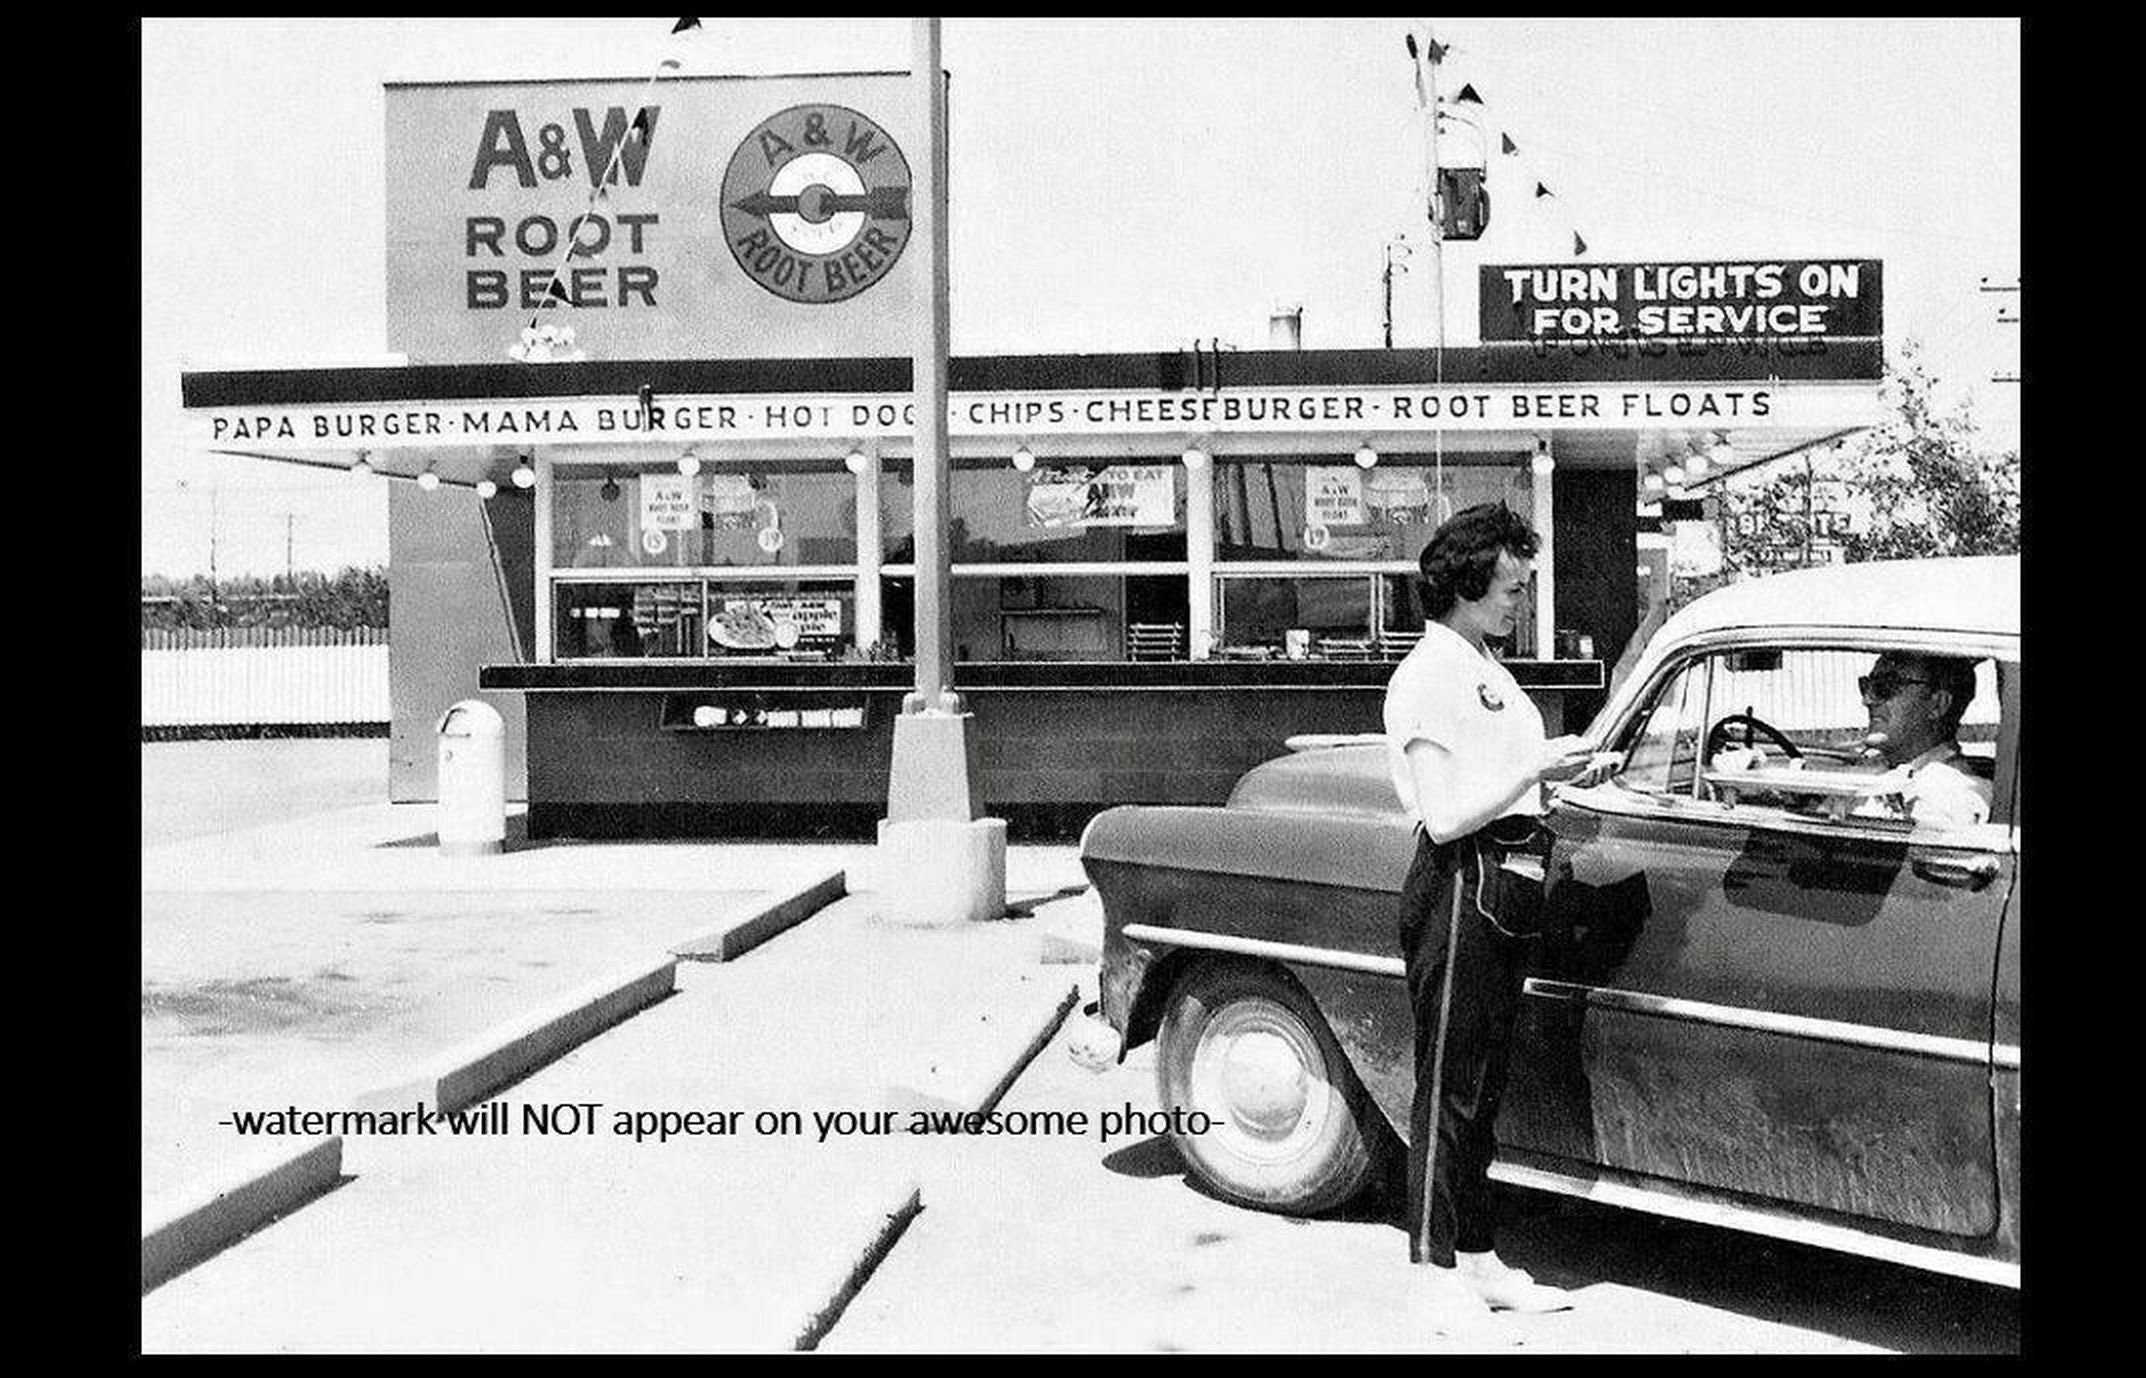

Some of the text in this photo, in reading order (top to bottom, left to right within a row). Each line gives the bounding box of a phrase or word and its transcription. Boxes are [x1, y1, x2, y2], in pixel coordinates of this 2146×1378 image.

[468, 105, 661, 189] A&W
[466, 213, 659, 257] ROOT
[737, 227, 898, 293] ROOT BEER
[466, 265, 659, 310] BEER
[1504, 264, 1861, 303] TURN LIGHTS ON
[1534, 304, 1830, 336] FOR SERVICE
[213, 416, 295, 440] PAPA
[313, 412, 441, 438] BURGER
[463, 410, 578, 434] MAMA
[599, 406, 736, 431] BURGER
[765, 405, 832, 428] HOT
[969, 401, 1065, 424] CHIPS
[1393, 395, 1490, 419] ROOT
[1512, 393, 1600, 418] BEER
[1622, 391, 1771, 417] FLOATS
